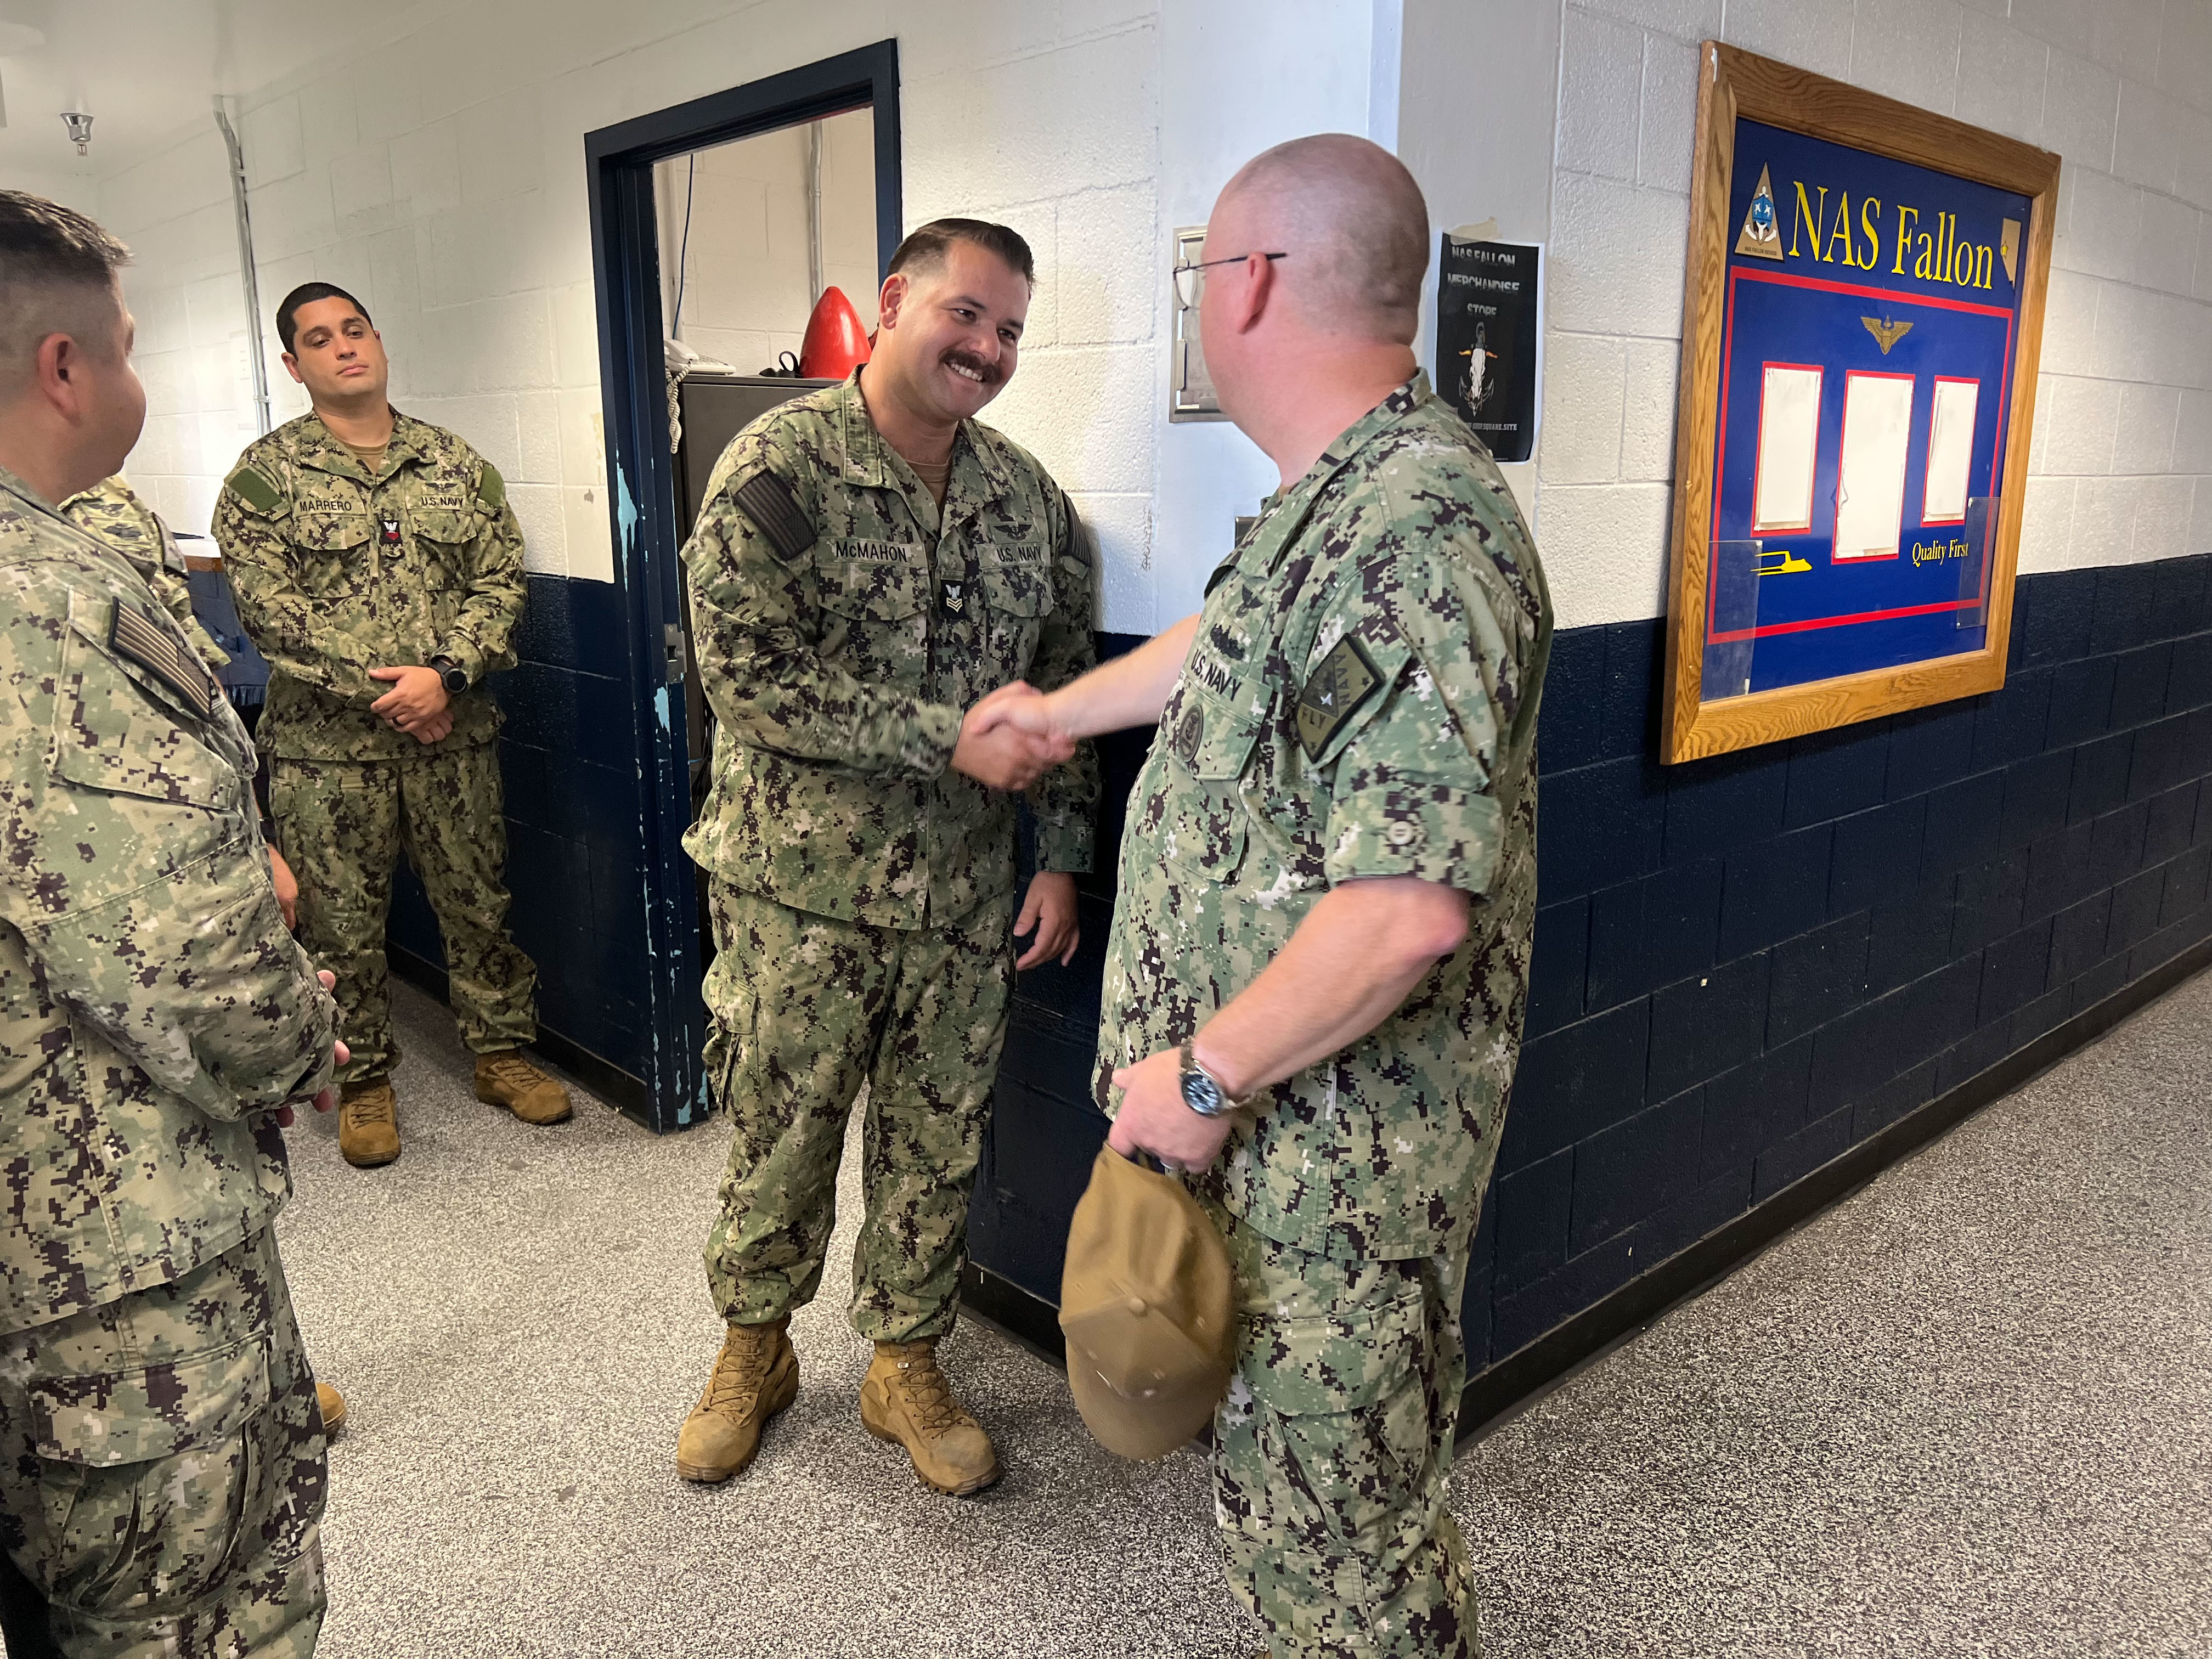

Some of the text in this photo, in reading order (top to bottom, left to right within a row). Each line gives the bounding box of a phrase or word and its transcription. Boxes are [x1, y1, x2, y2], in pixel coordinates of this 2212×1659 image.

[1788, 180, 1994, 290] NAS Fallon
[1452, 246, 1516, 267] NAS FALLON
[1447, 273, 1520, 292] MERCHANDISE
[1467, 303, 1497, 317] STORE
[300, 500, 352, 512] MARRERO
[421, 497, 464, 507] U.S. NAVY
[836, 540, 908, 563] McMAHON
[996, 546, 1043, 563] U.S. NAVY
[1912, 538, 1969, 568] Quality First
[1190, 648, 1243, 703] U.S. NAVY
[1334, 653, 1351, 707] NAVY
[1302, 707, 1327, 730] FLY
